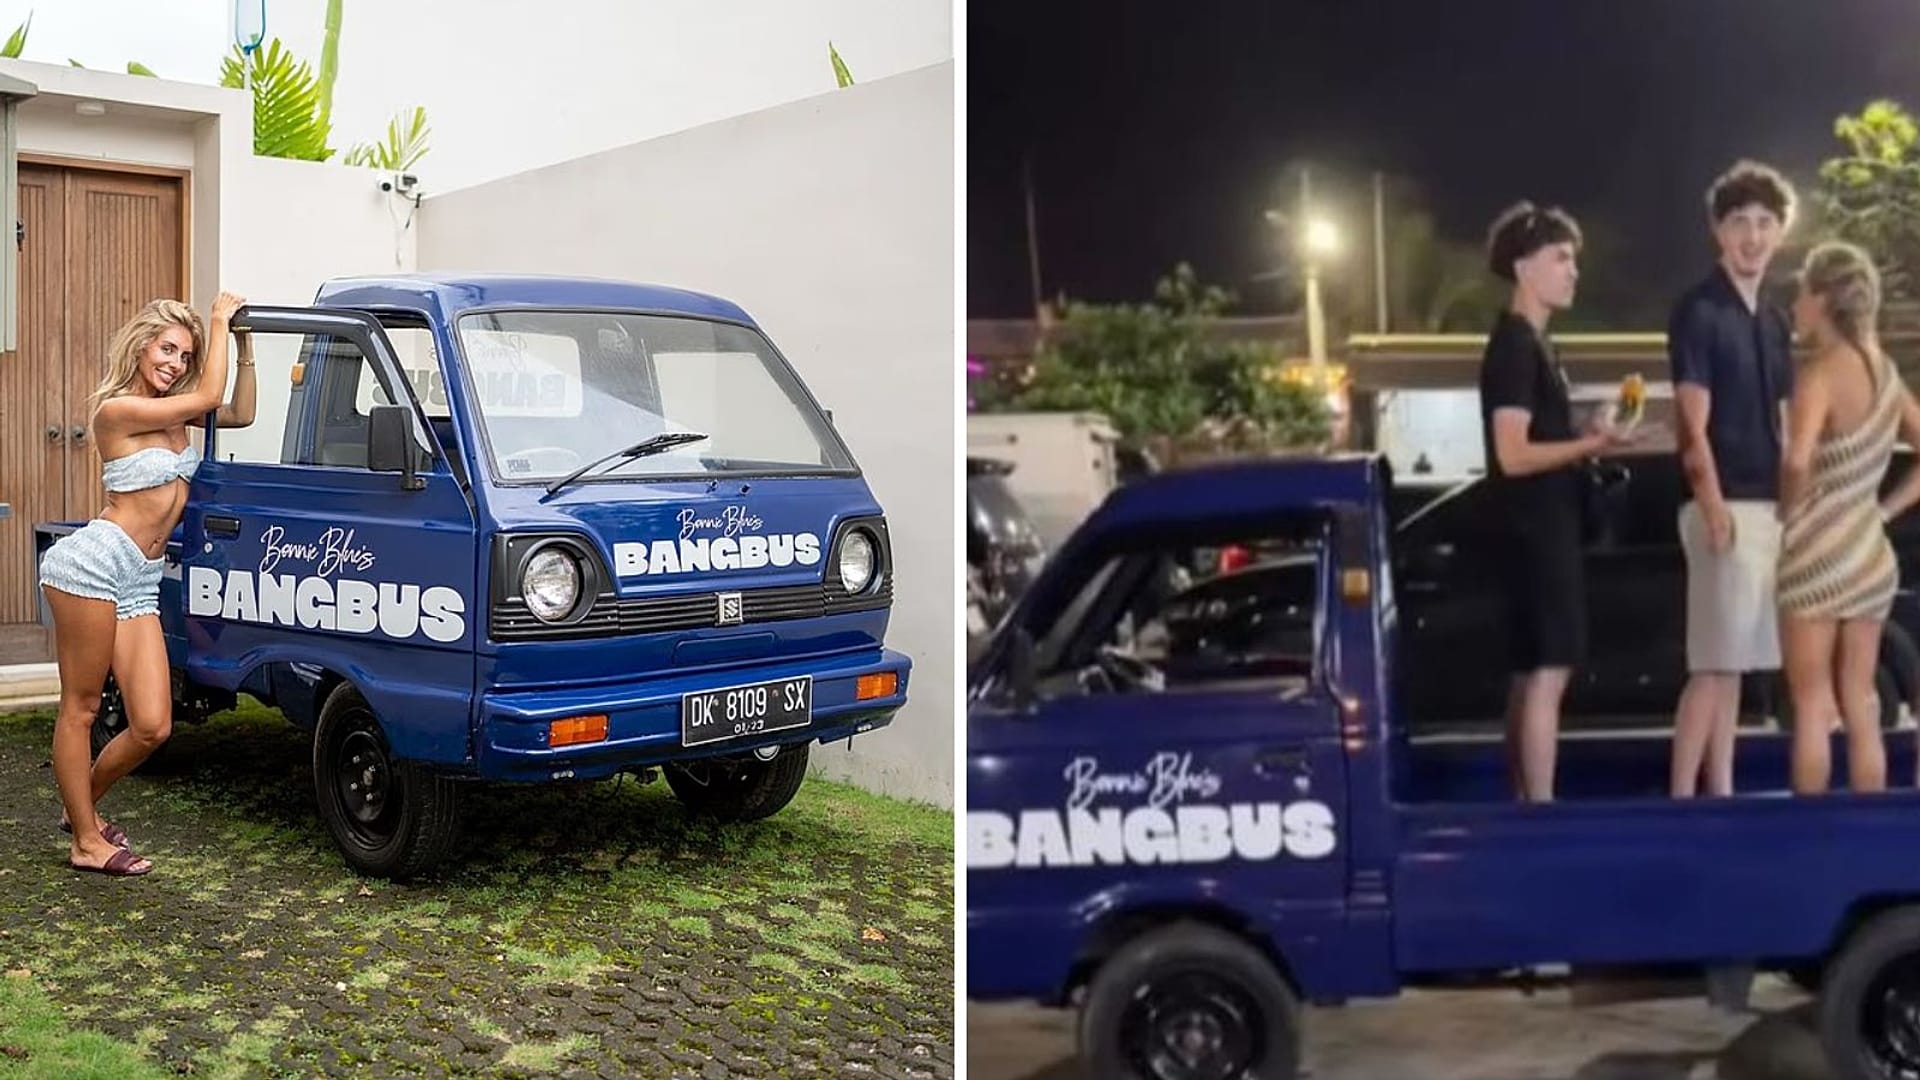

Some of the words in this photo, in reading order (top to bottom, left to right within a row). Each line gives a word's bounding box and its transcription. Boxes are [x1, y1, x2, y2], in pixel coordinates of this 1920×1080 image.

[259, 525, 318, 575] Bonnie
[613, 533, 821, 577] BANGBUS
[189, 566, 465, 642] BANGBUS
[692, 695, 714, 727] DK
[726, 687, 767, 720] 8109
[784, 680, 806, 711] SX
[967, 801, 1335, 868] BANGBUS
